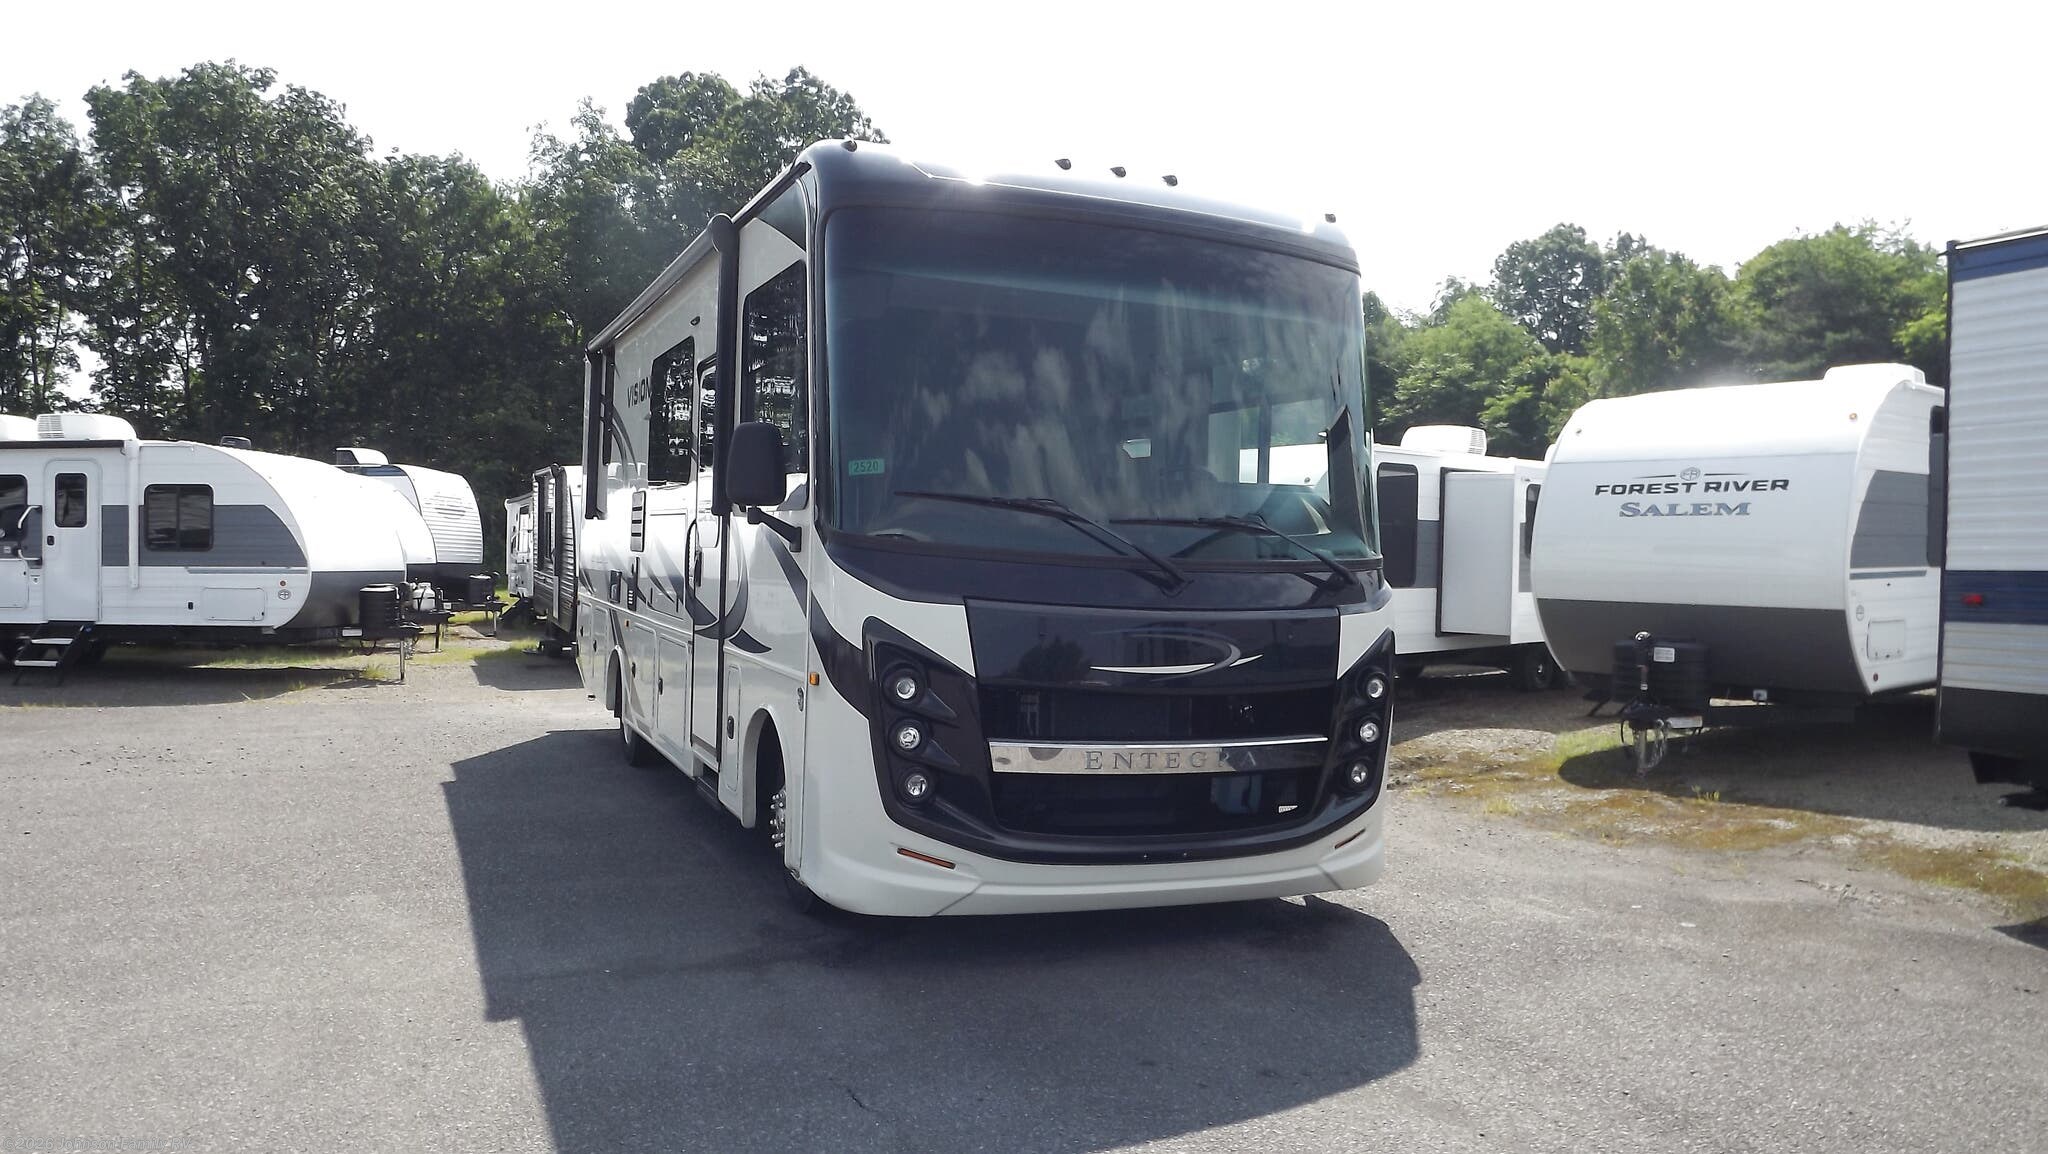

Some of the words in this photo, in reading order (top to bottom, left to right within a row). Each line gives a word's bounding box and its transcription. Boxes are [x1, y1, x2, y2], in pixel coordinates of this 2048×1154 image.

[627, 376, 651, 408] VISION
[853, 460, 880, 473] 2520
[1594, 482, 1698, 496] FOREST
[1703, 479, 1790, 494] RIVER
[1084, 750, 1258, 771] ENTEGRA
